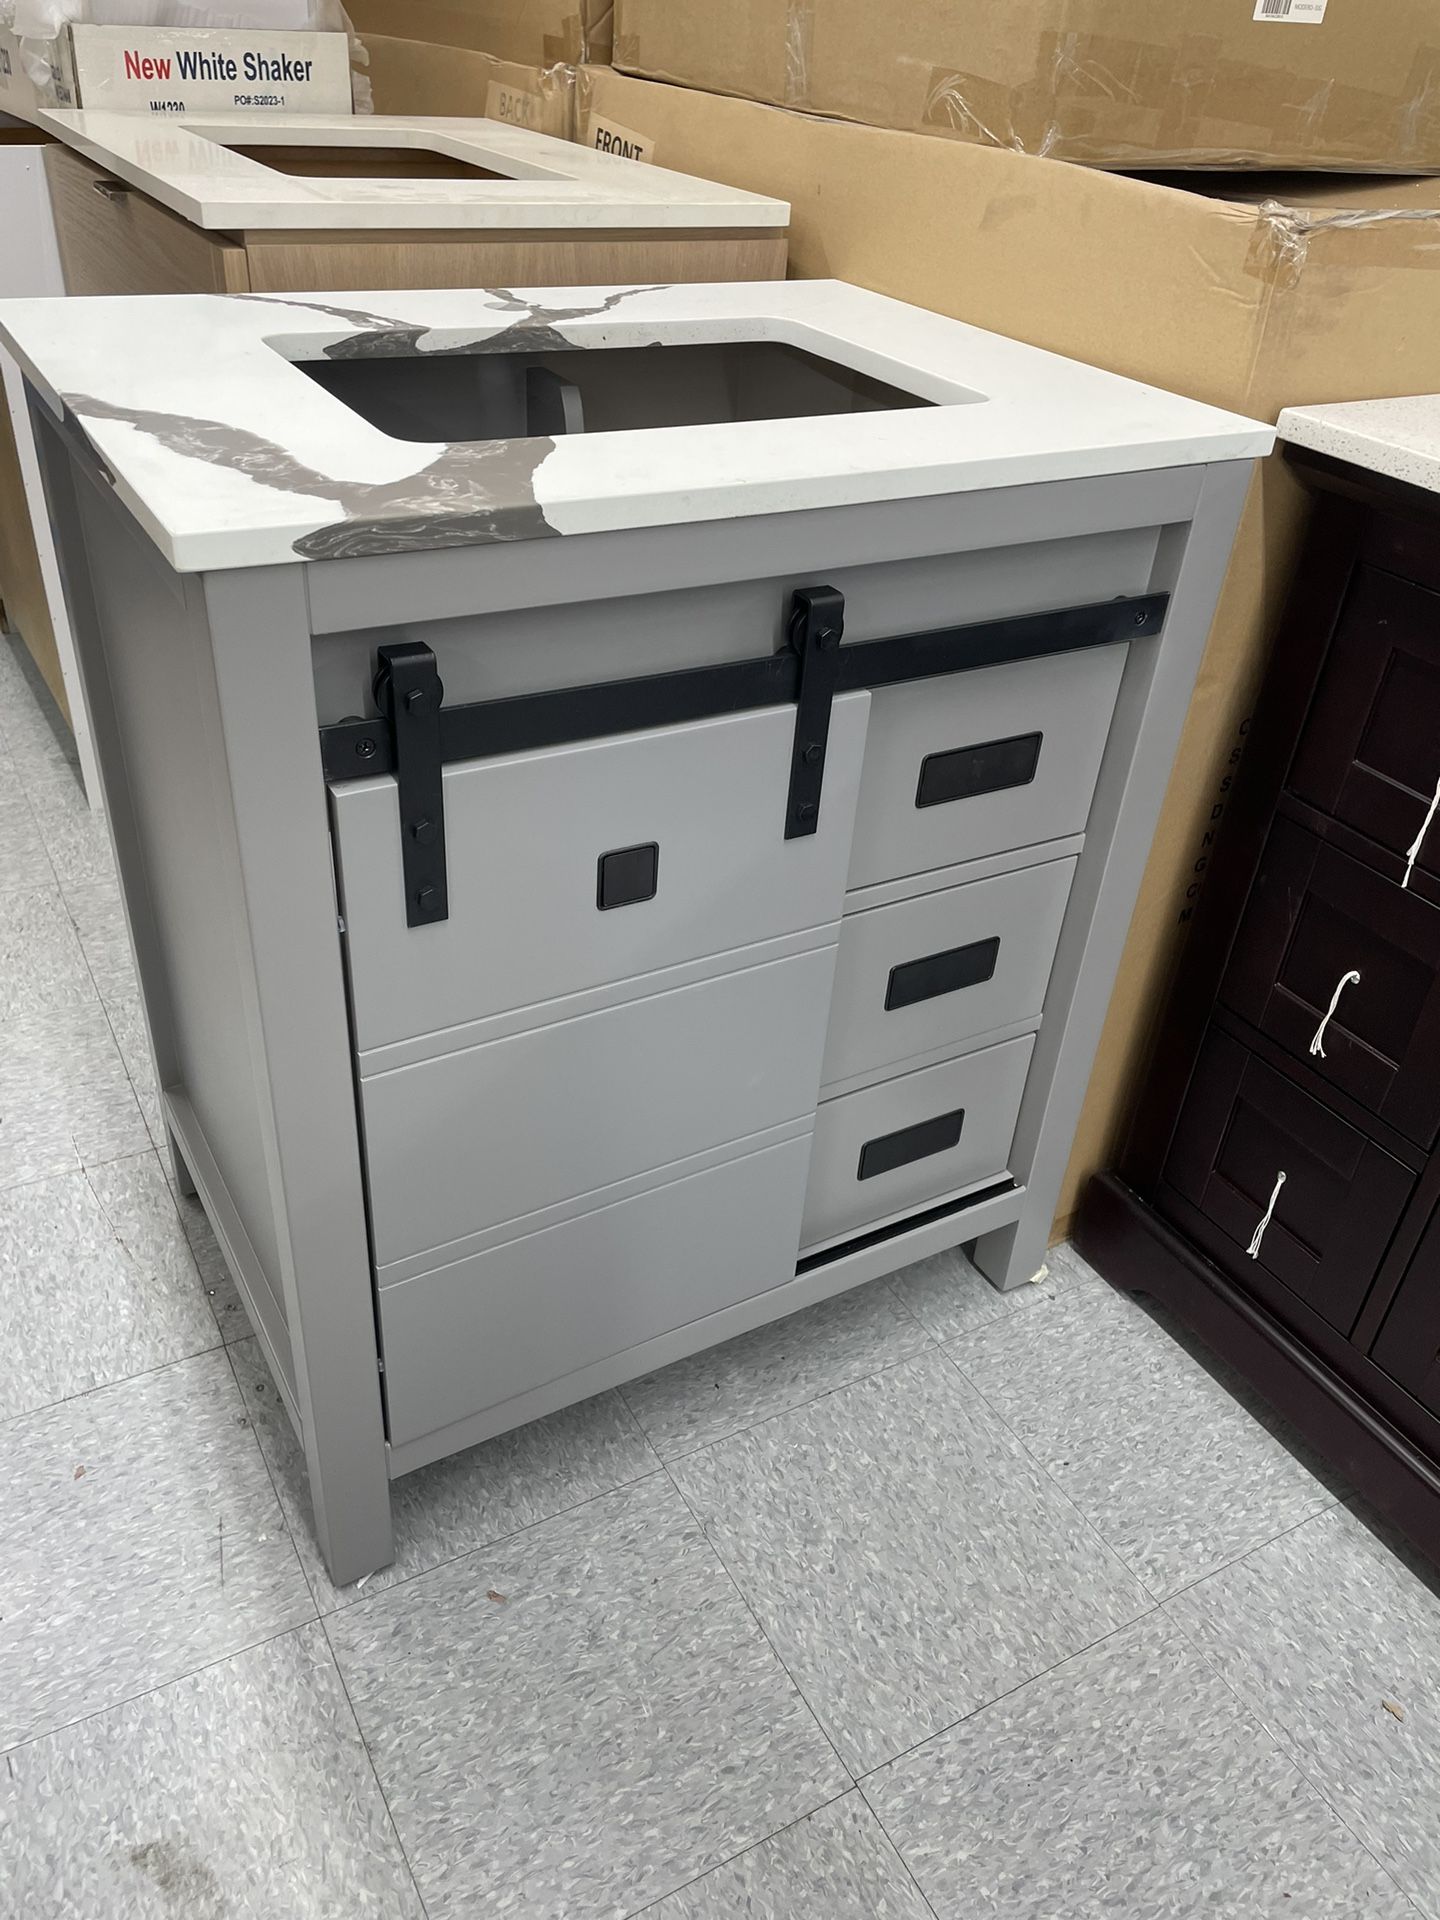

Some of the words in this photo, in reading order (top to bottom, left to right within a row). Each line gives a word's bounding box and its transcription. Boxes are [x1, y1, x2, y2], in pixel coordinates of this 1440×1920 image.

[124, 50, 171, 80] New
[176, 51, 238, 81] White
[243, 52, 313, 82] Shaker
